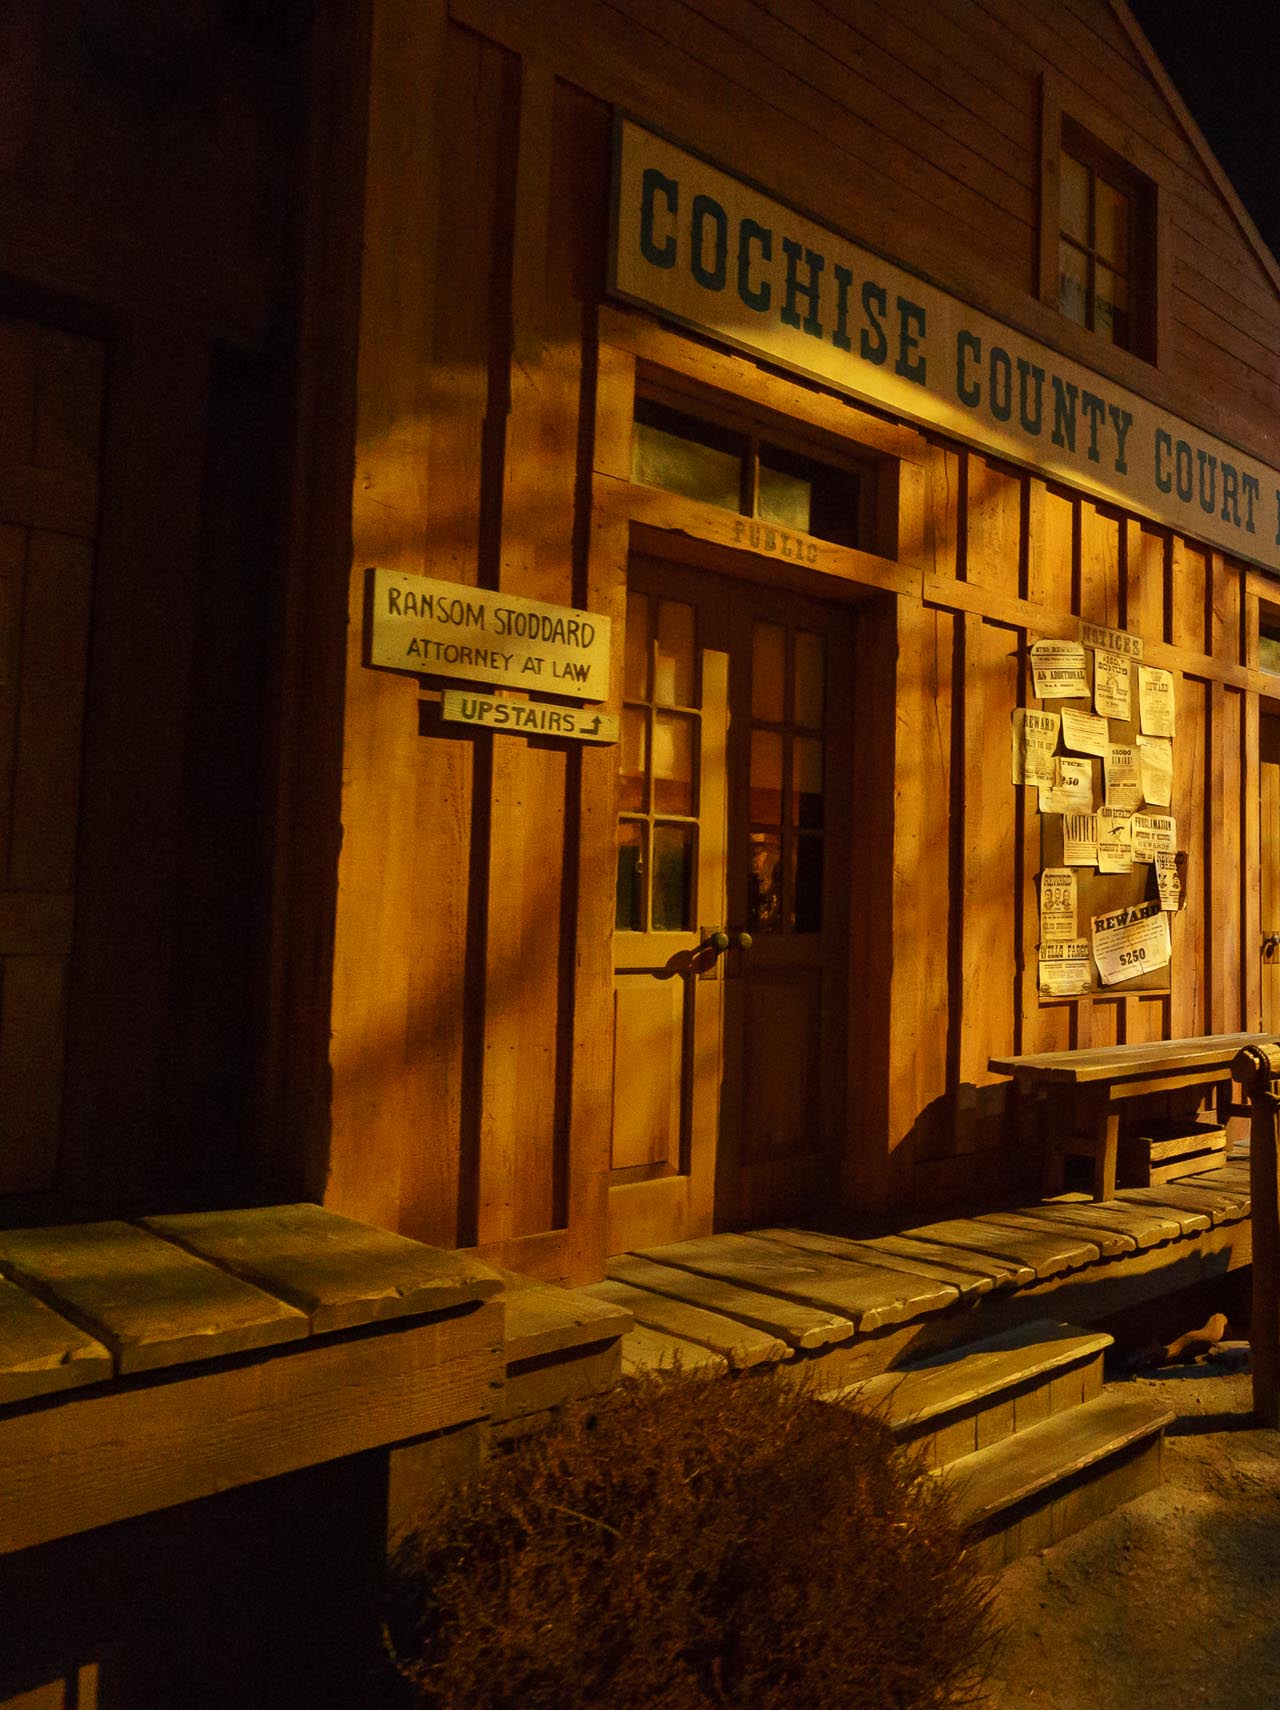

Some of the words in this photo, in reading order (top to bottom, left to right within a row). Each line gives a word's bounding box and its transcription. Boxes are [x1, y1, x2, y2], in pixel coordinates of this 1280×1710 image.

[640, 168, 926, 387] COCHISE
[957, 329, 1133, 475] COUNTY
[1154, 428, 1260, 535] COURT
[735, 520, 818, 563] PUBLIC
[388, 587, 485, 631] RANSOM
[494, 607, 595, 649] STODDARD
[1082, 626, 1140, 656] NOTICES
[406, 637, 514, 671] ATTORNEY
[521, 656, 545, 675] AT
[552, 660, 592, 683] LAW
[1050, 670, 1085, 681] ADDITIONAL
[461, 698, 575, 732] UPSTAIRS
[1024, 714, 1055, 732] REWARD
[1094, 905, 1161, 933] REWARD
[1118, 947, 1146, 967] $250
